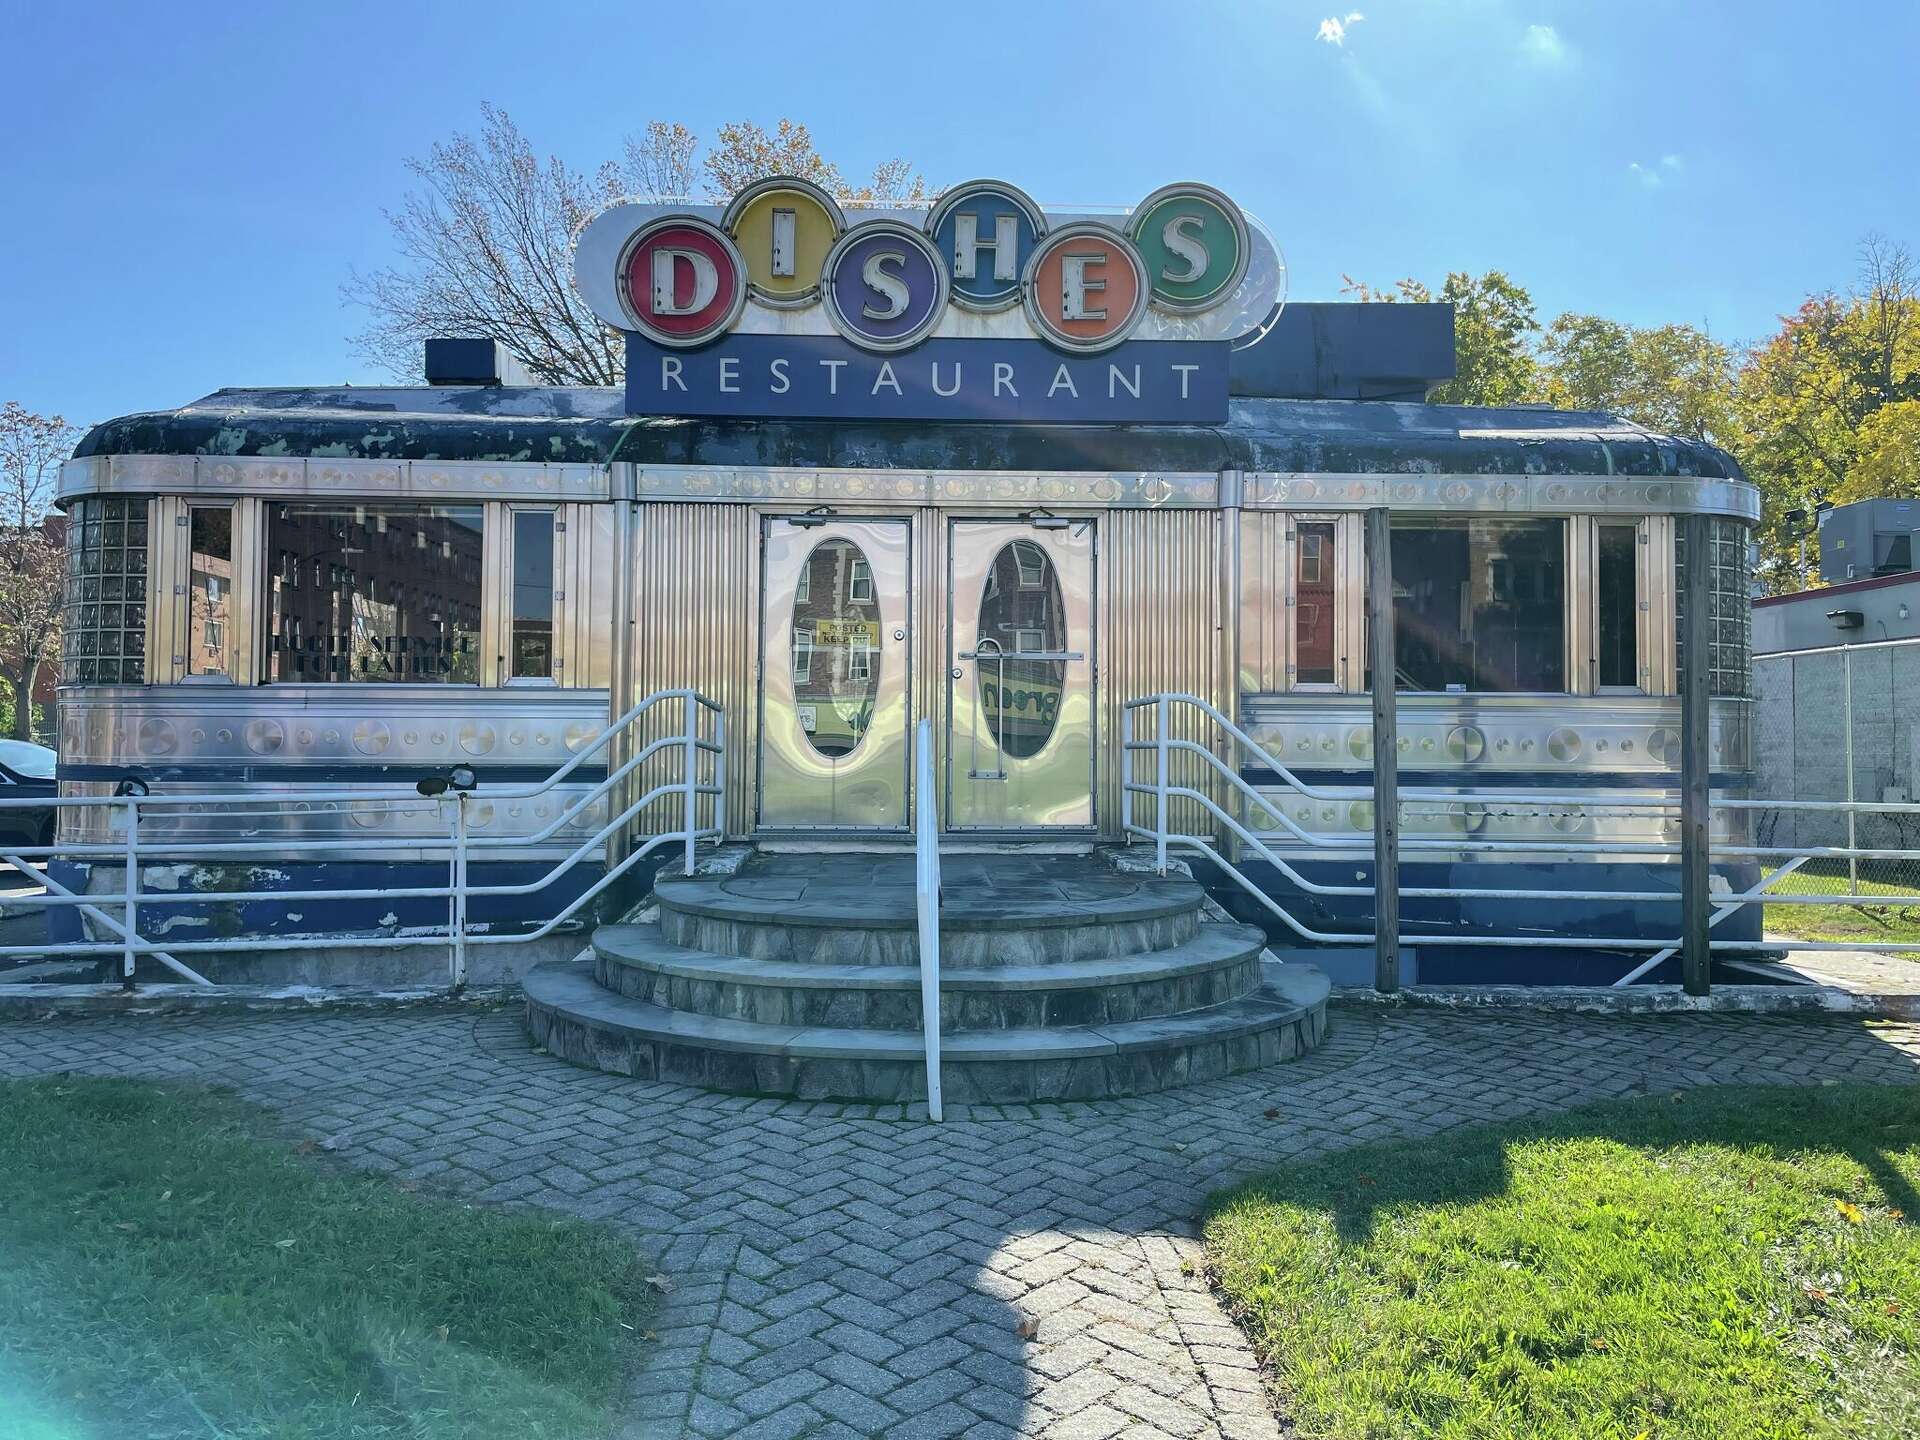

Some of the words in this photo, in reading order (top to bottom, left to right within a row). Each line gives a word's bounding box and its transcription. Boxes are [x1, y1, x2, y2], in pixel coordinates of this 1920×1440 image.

[651, 207, 1212, 321] DISHES
[661, 356, 1201, 400] RESTAURANT
[829, 624, 867, 633] POSTED
